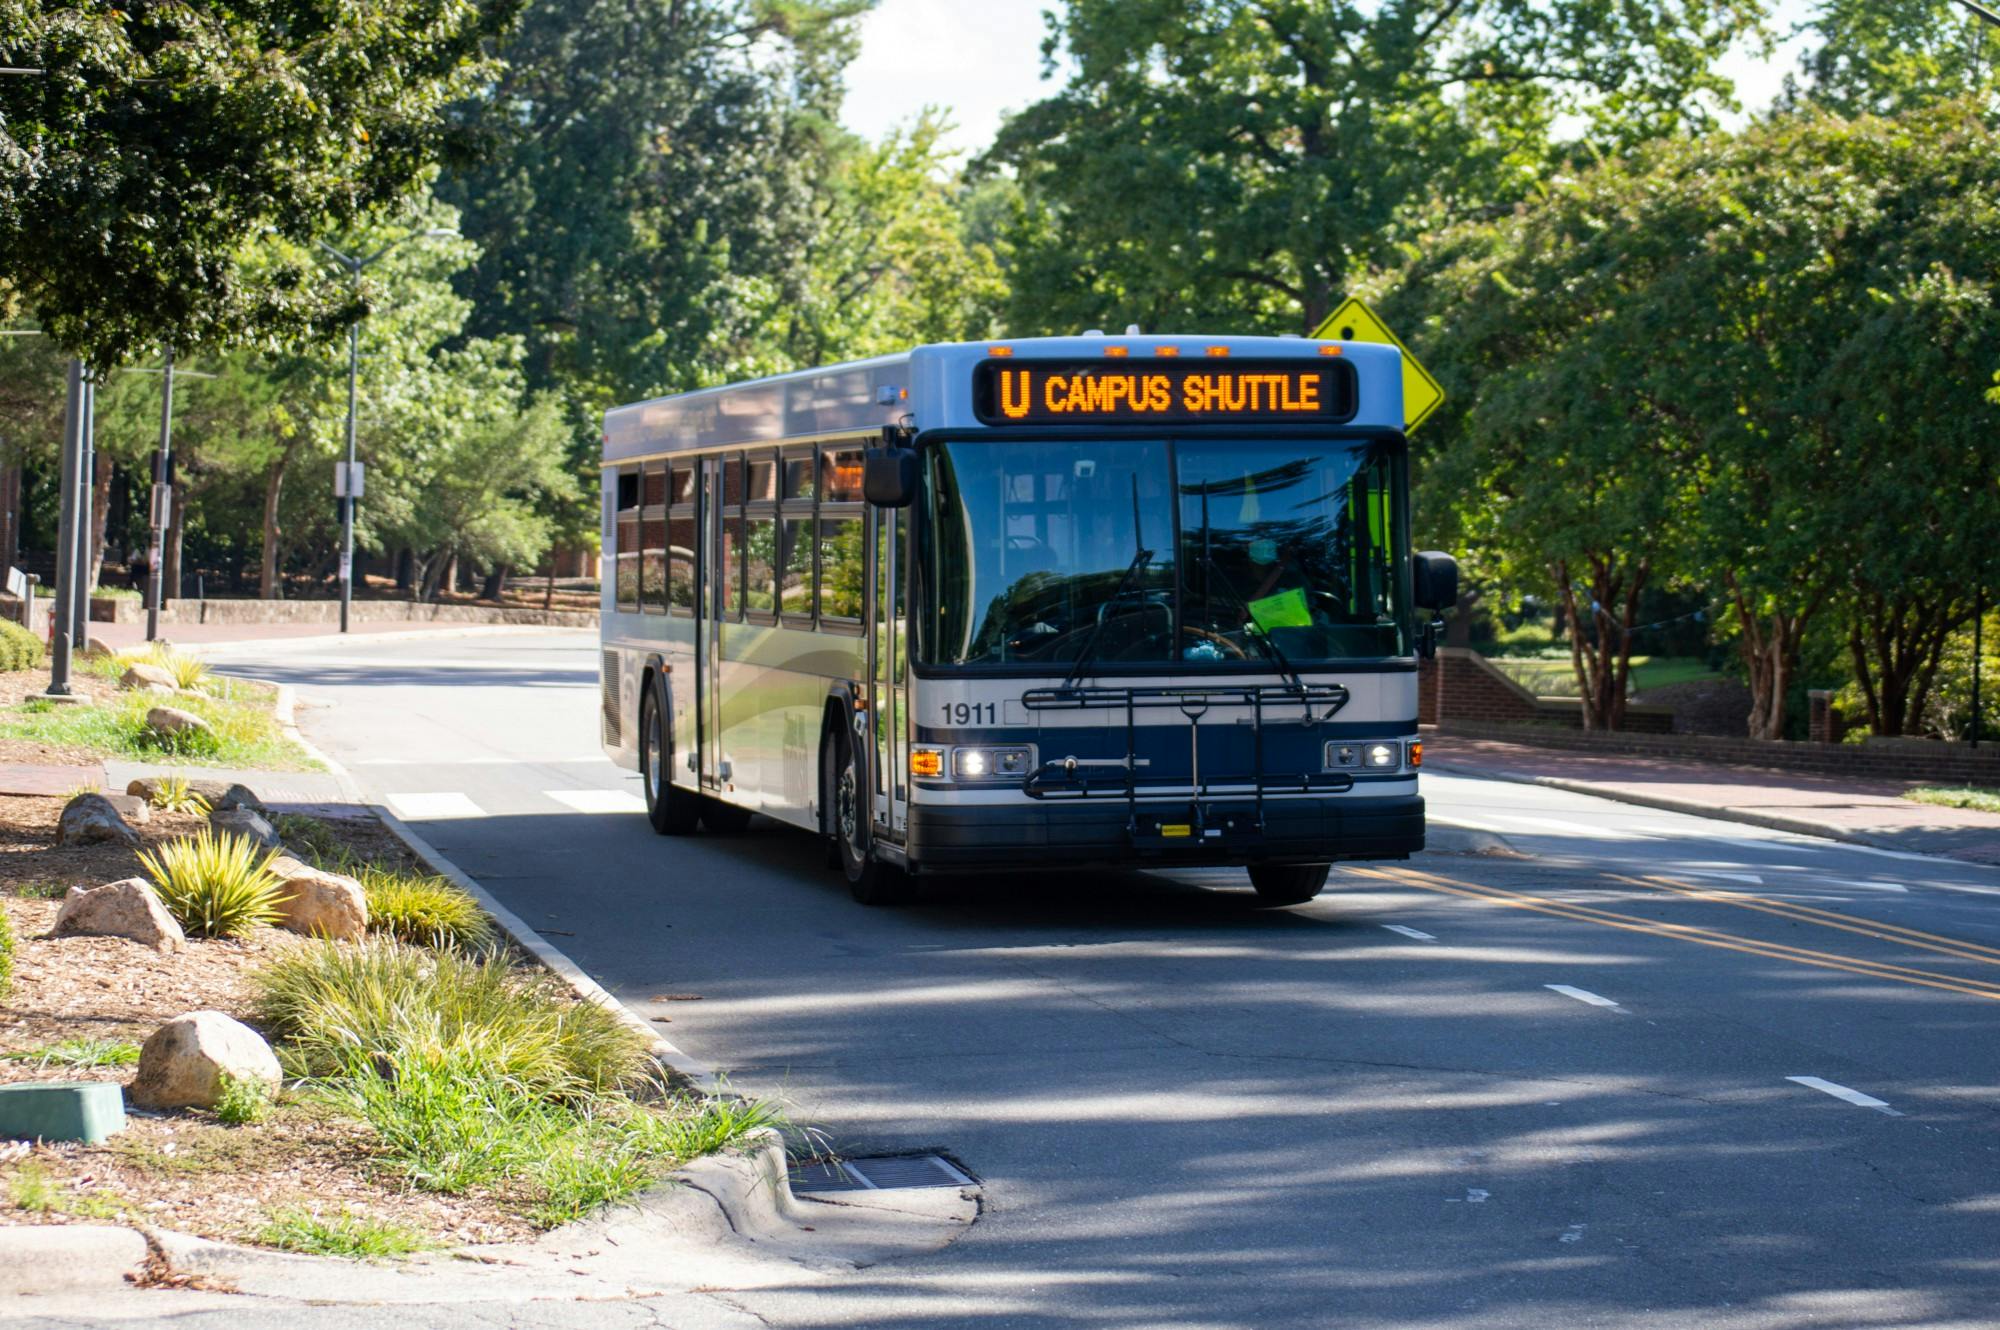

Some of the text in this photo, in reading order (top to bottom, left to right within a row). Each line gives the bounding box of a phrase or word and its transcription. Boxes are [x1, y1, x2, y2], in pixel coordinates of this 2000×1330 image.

[1001, 371, 1321, 418] U CAMPUS SHUTTLE
[942, 702, 995, 725] 1911
